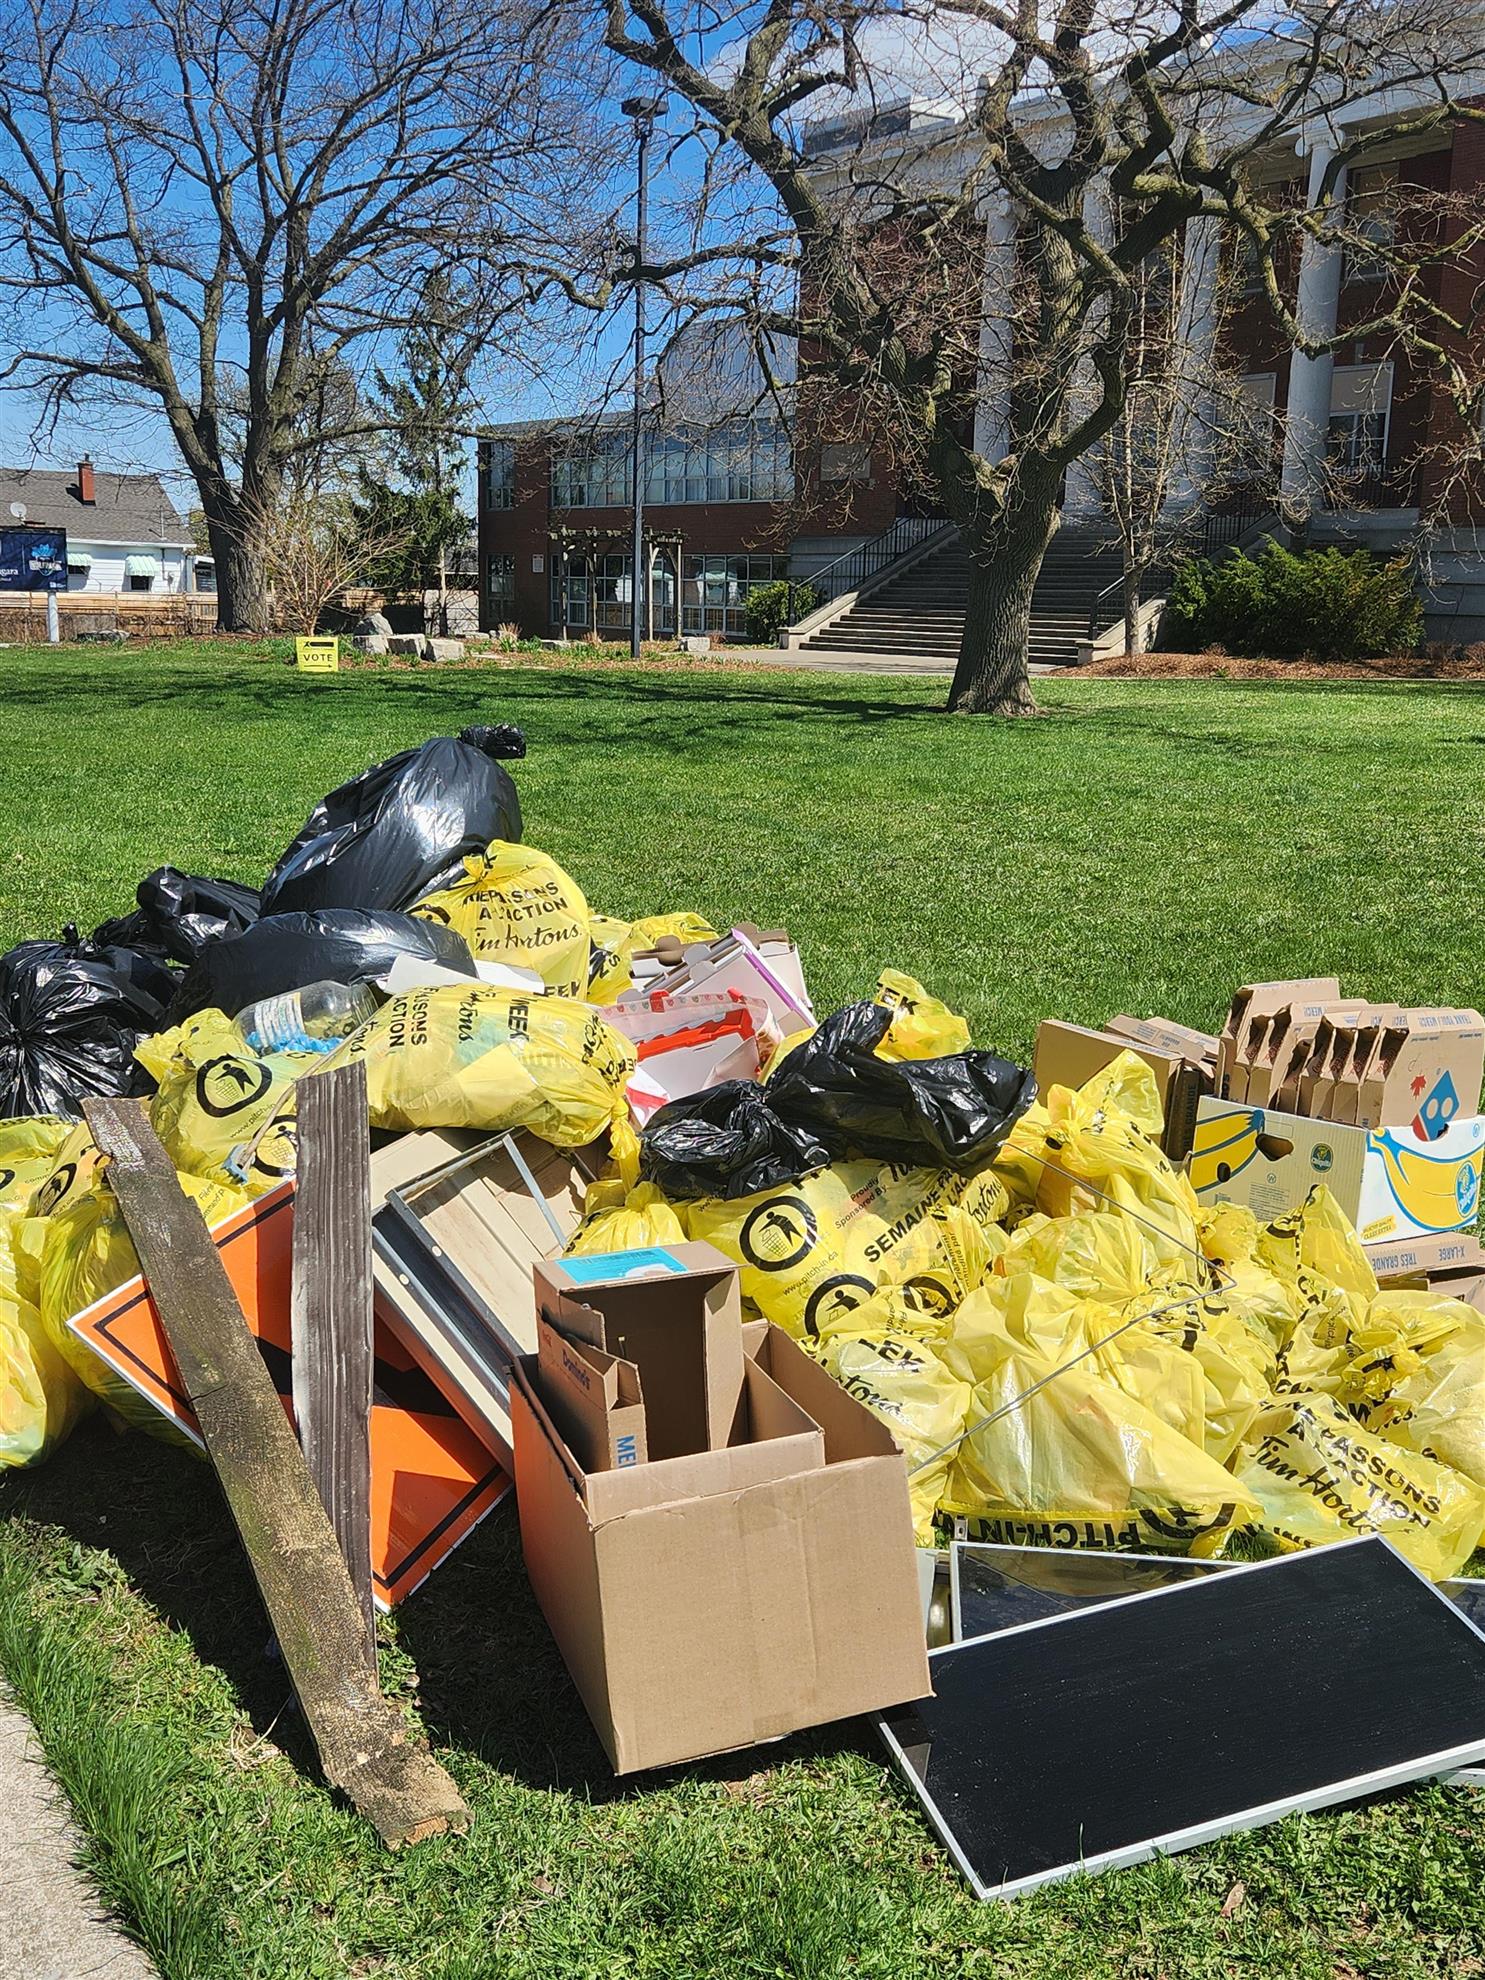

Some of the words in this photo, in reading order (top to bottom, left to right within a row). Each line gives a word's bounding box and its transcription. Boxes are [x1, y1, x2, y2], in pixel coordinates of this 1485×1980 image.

[303, 653, 333, 662] VOTE
[389, 996, 408, 1048] ACTION
[850, 1176, 880, 1202] Proudly
[834, 1194, 876, 1230] Sponsored
[875, 1184, 888, 1198] By
[864, 1189, 941, 1263] SEMAINE
[1371, 1255, 1399, 1271] GRANDE
[1438, 1245, 1465, 1261] X-LARGE
[1249, 1435, 1299, 1481] Tim
[978, 1517, 1141, 1548] PITCH-IN
